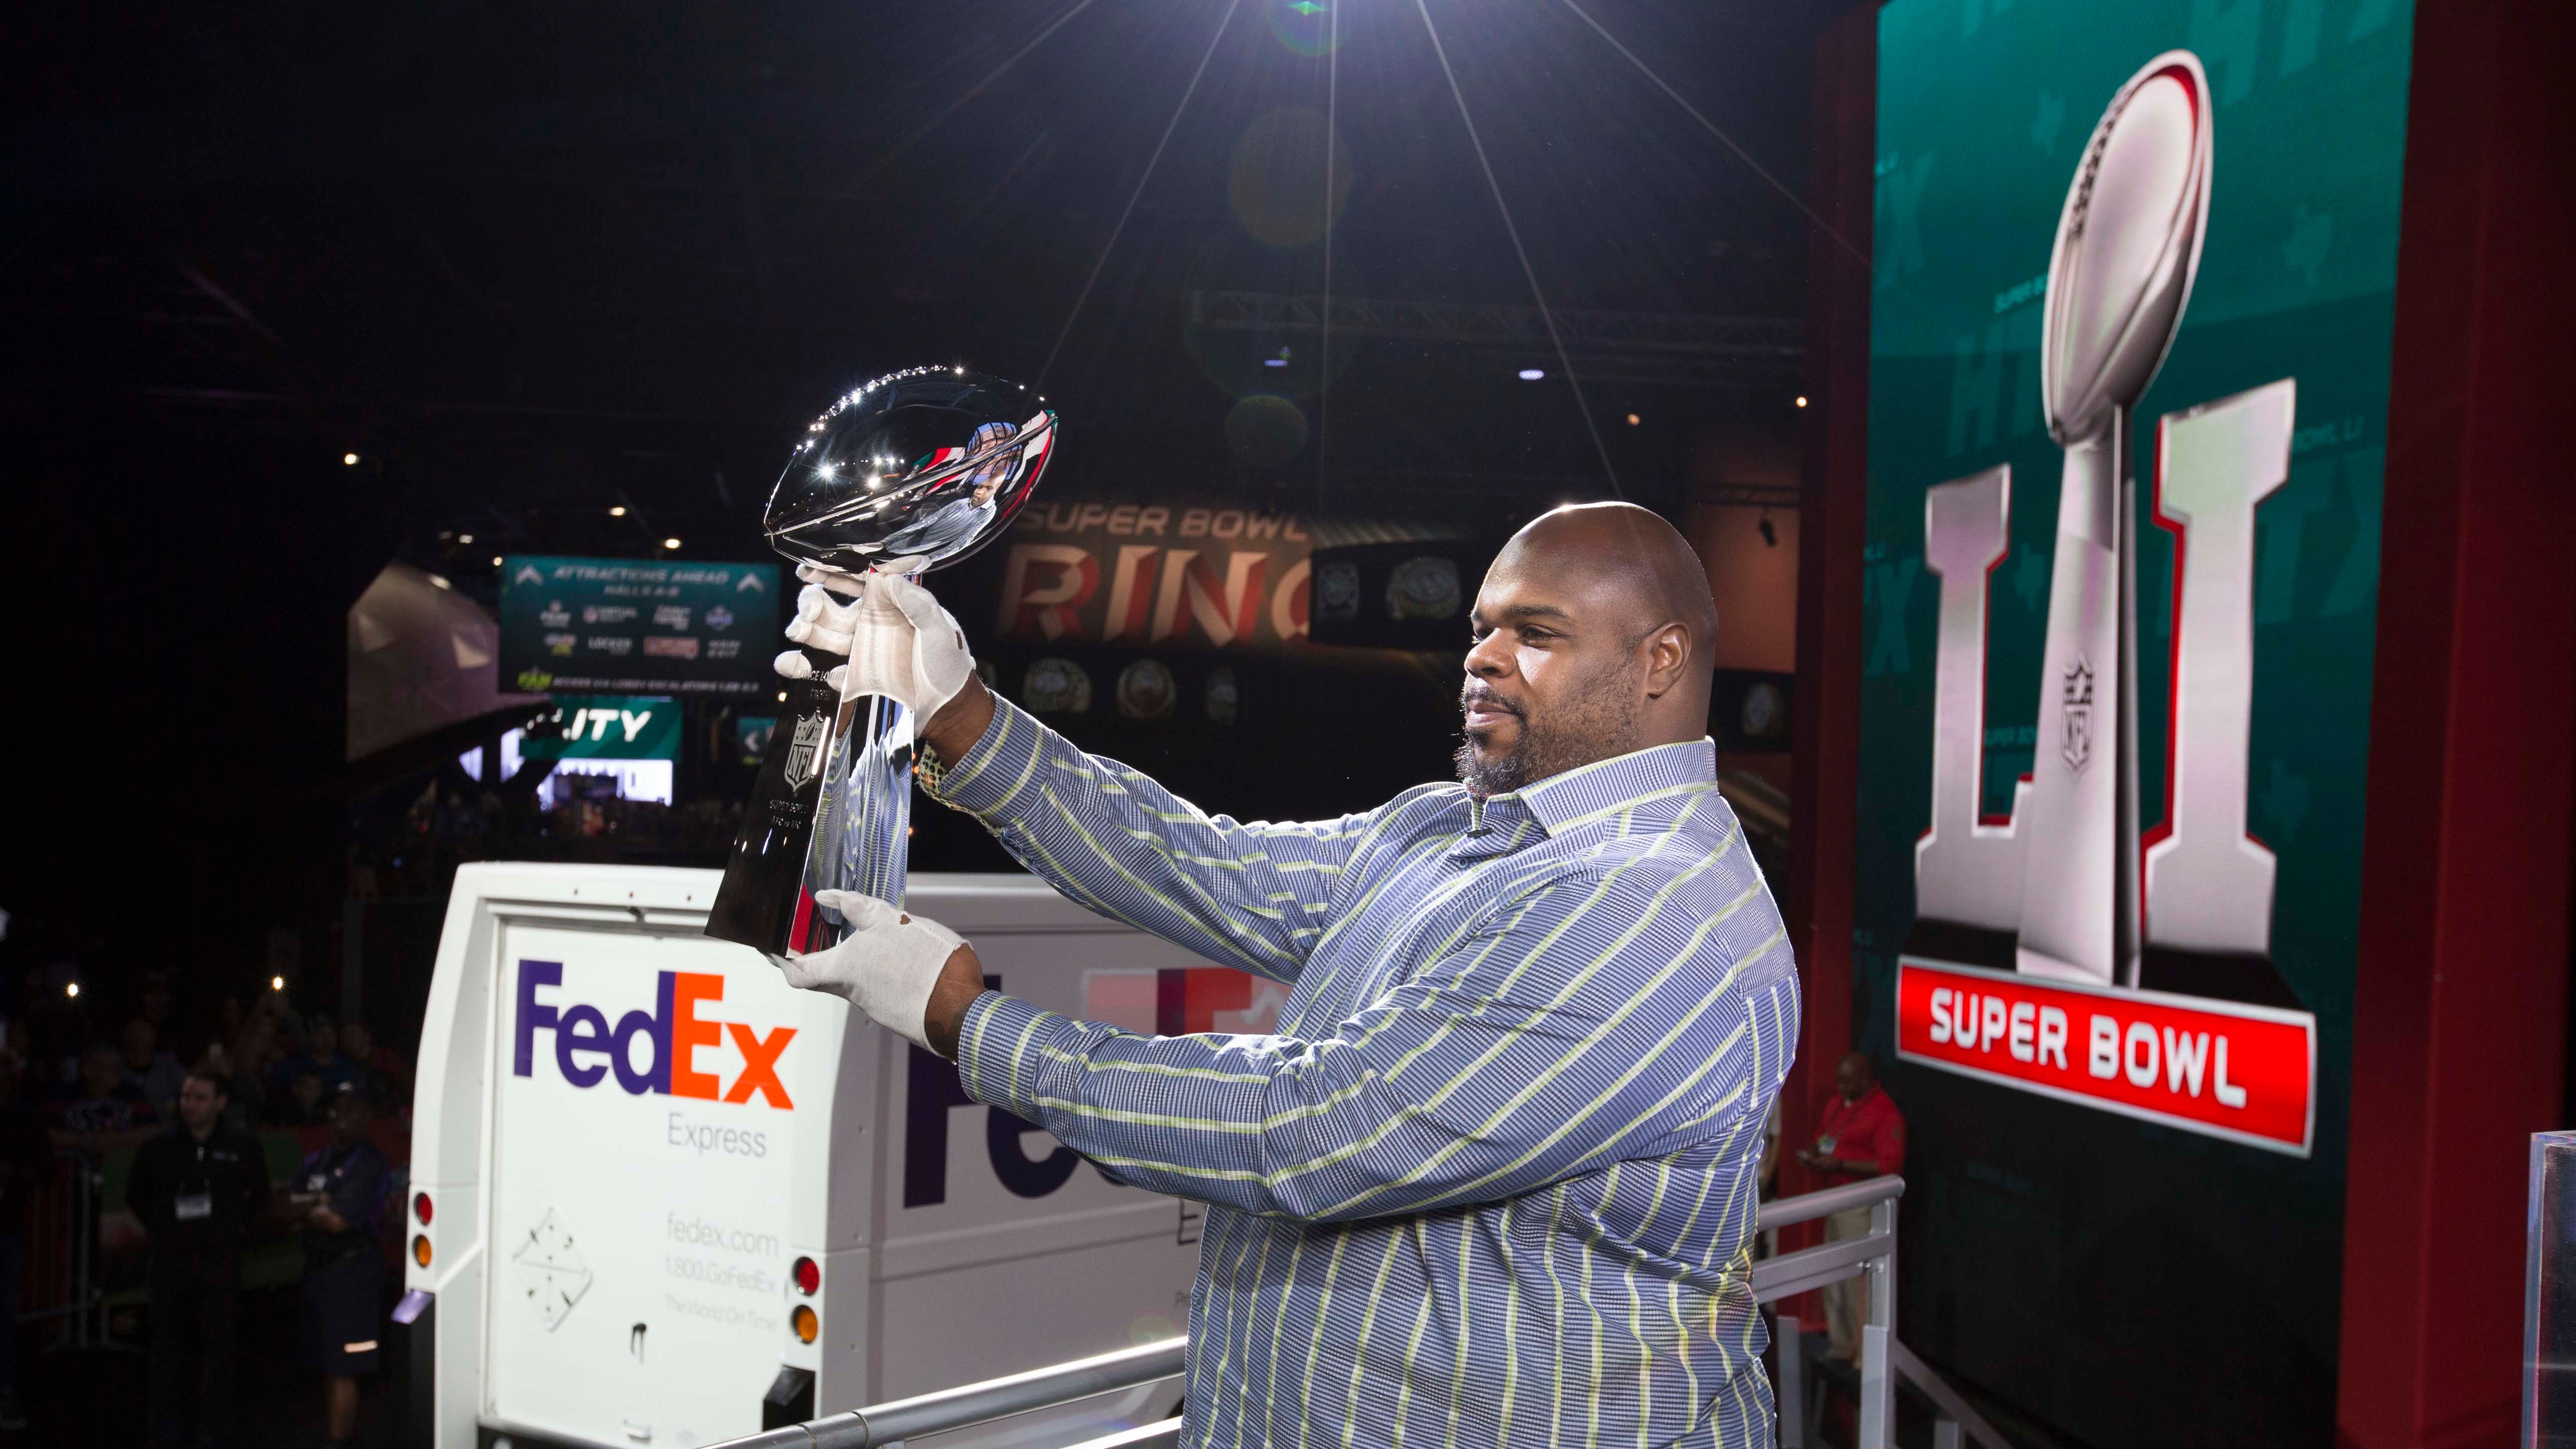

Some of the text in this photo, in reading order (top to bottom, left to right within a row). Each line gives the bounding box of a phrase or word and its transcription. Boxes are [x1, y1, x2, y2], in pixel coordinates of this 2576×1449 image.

[1017, 503, 1308, 540] SUPER BOWL
[554, 565, 730, 585] ATTRACTIONS AHEAD
[562, 708, 652, 742] ITY
[788, 745, 815, 778] NFL
[513, 958, 798, 1111] FedEx
[1929, 988, 2248, 1109] SUPER BOWL
[667, 1111, 766, 1158] Express
[667, 1210, 779, 1256] fedex.com
